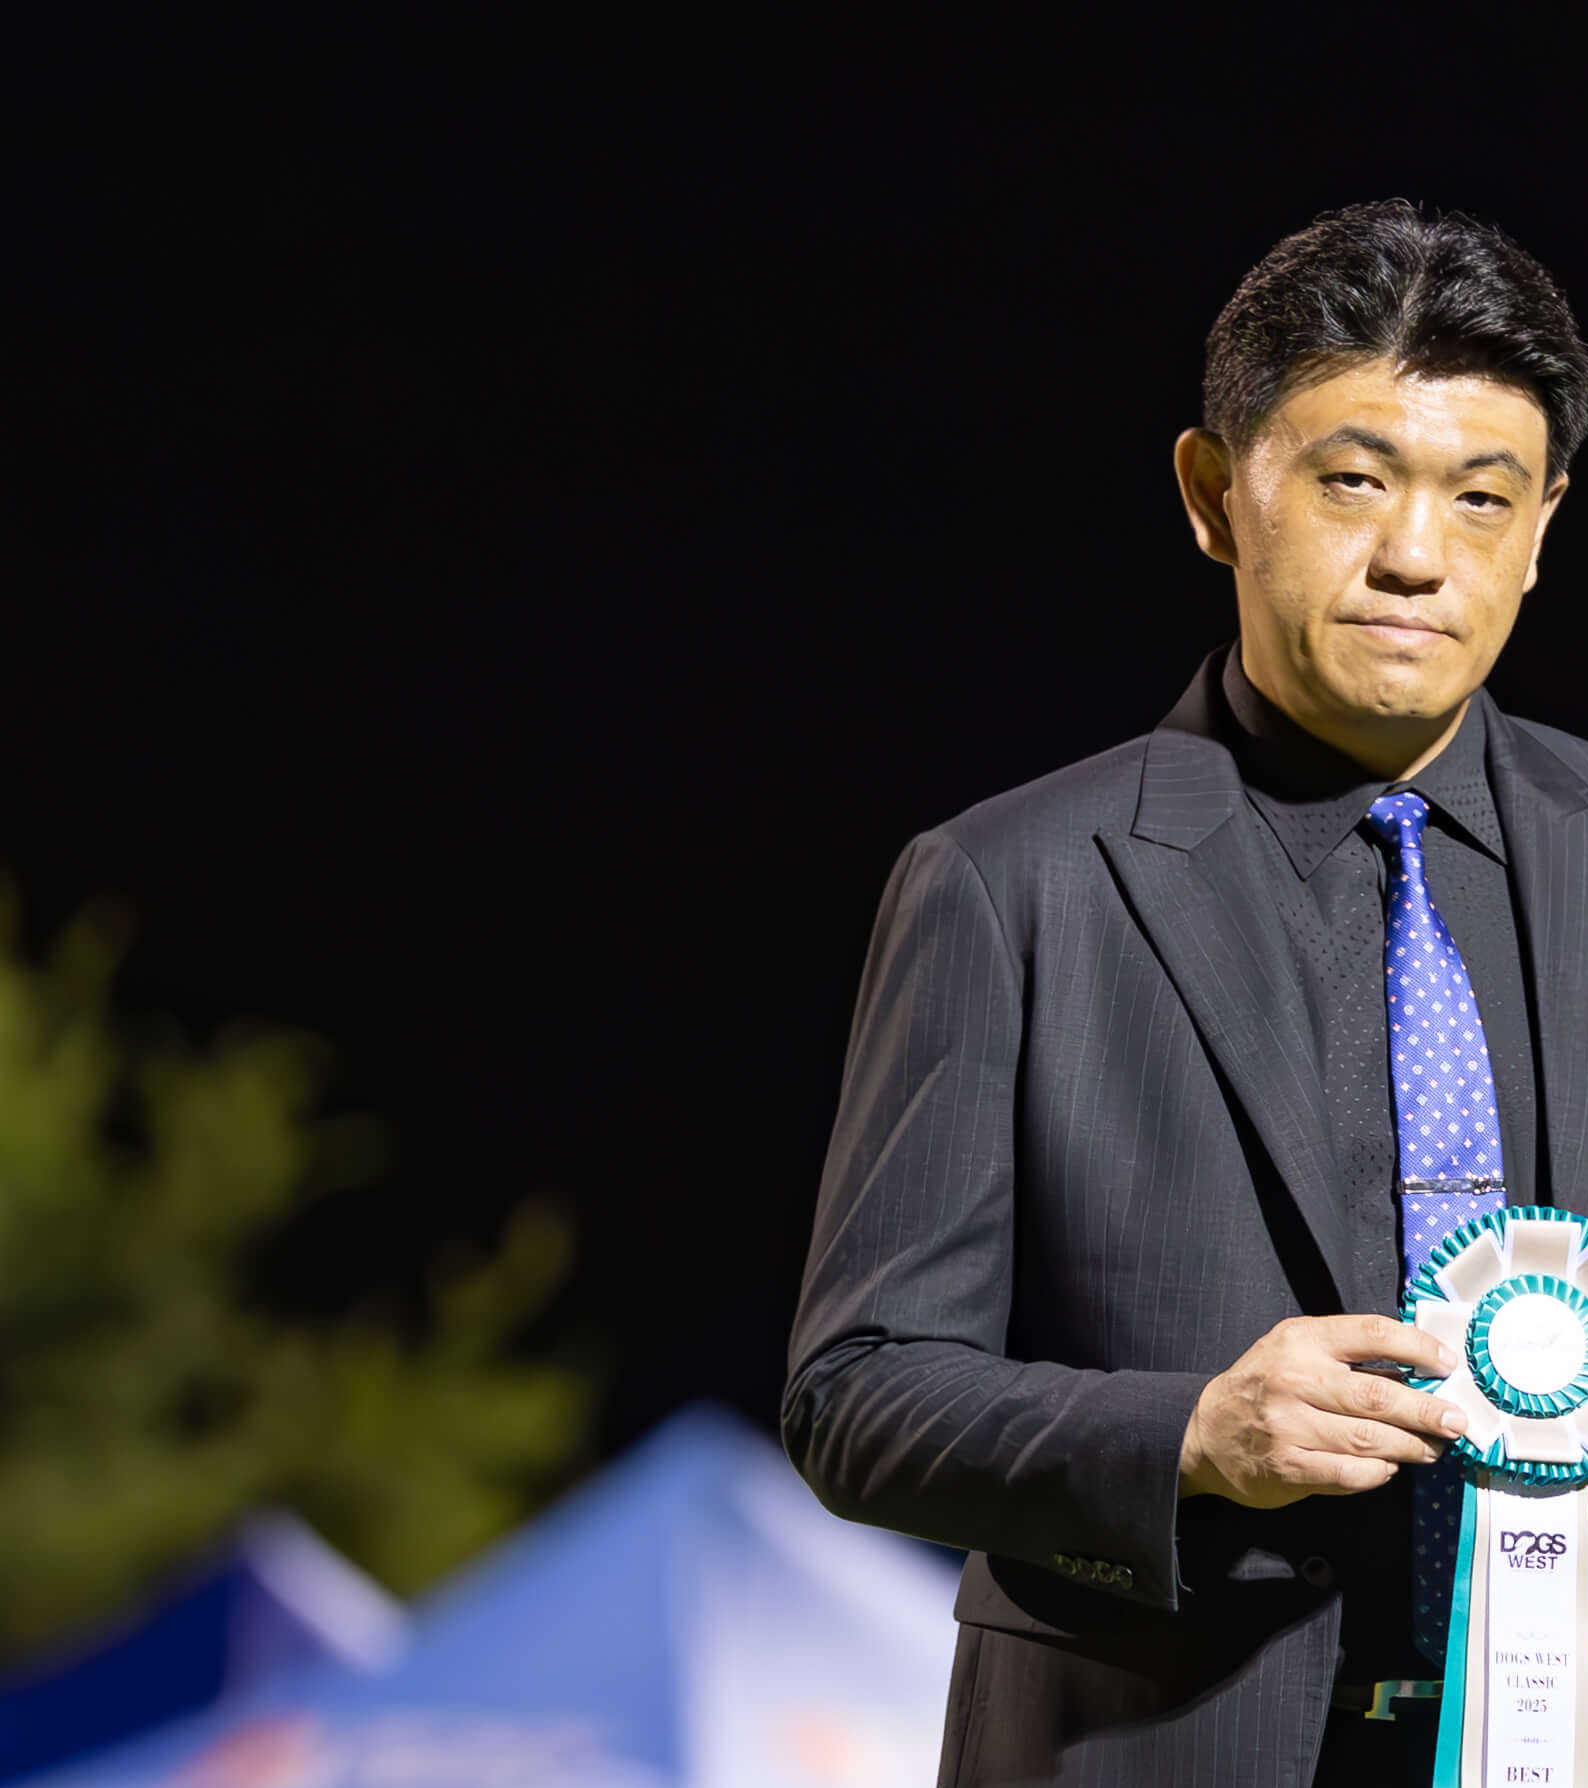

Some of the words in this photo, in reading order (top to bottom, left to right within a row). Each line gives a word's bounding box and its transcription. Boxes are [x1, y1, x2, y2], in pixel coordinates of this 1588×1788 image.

[1500, 1530, 1567, 1555] DOGS
[1507, 1554, 1559, 1570] WEST
[1516, 1698, 1548, 1713] 2025
[1506, 1765, 1555, 1784] BEST
